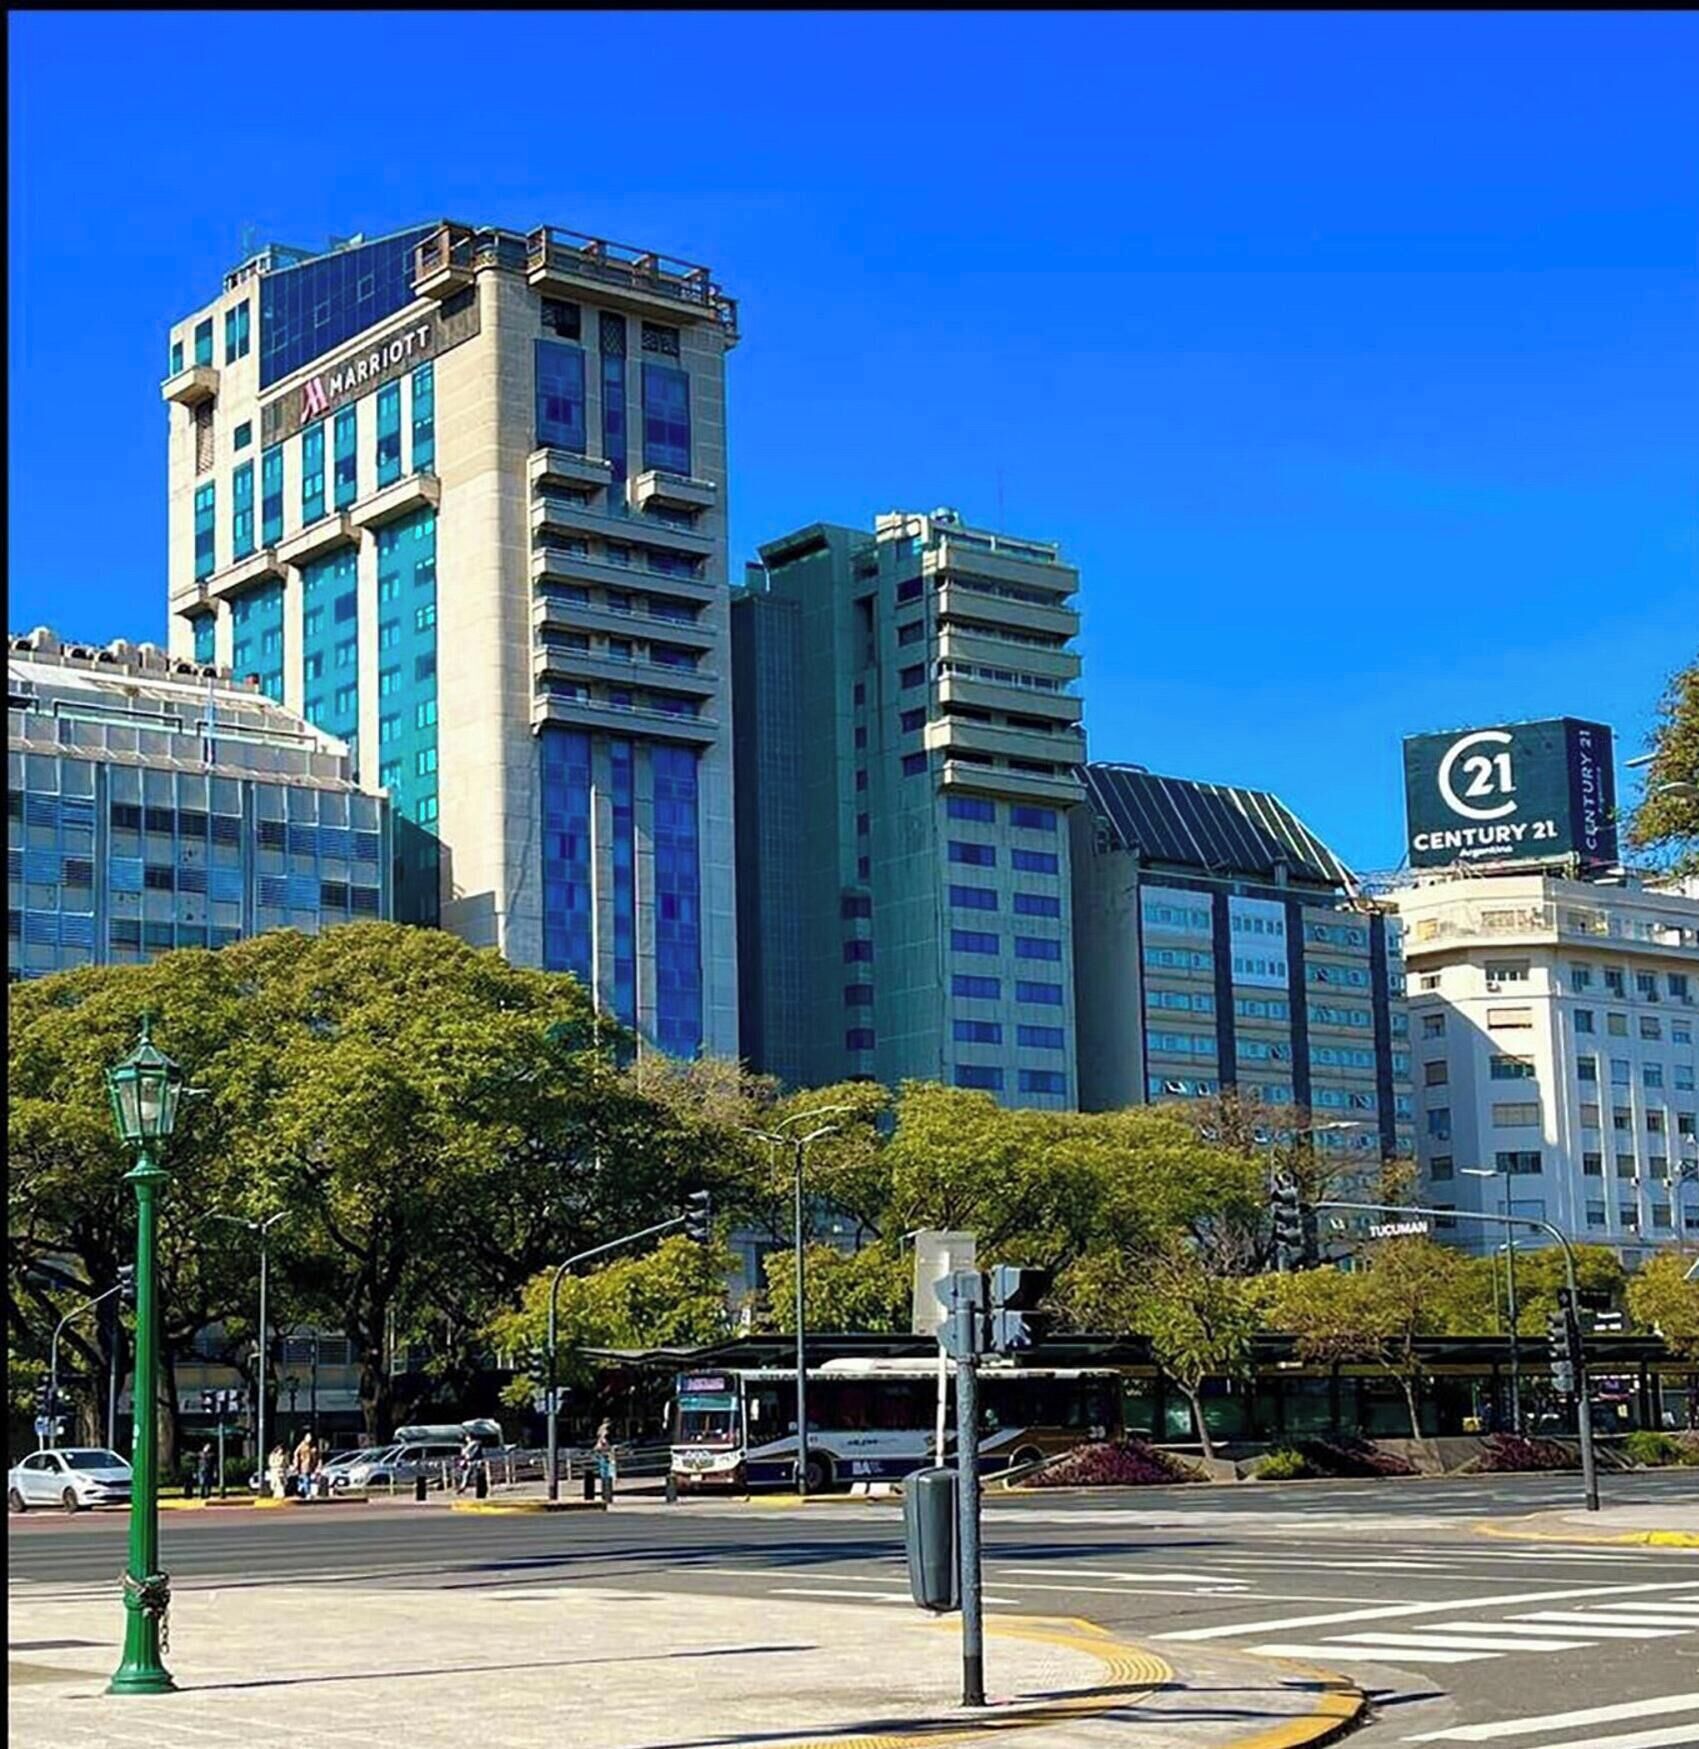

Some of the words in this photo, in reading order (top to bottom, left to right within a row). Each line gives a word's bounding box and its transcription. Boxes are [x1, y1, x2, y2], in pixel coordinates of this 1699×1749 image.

[329, 325, 430, 397] MARRIOTT
[1462, 753, 1517, 798] 21
[1579, 752, 1598, 851] CENTURY
[1413, 821, 1528, 852] CENTURY
[1531, 820, 1558, 840] 21
